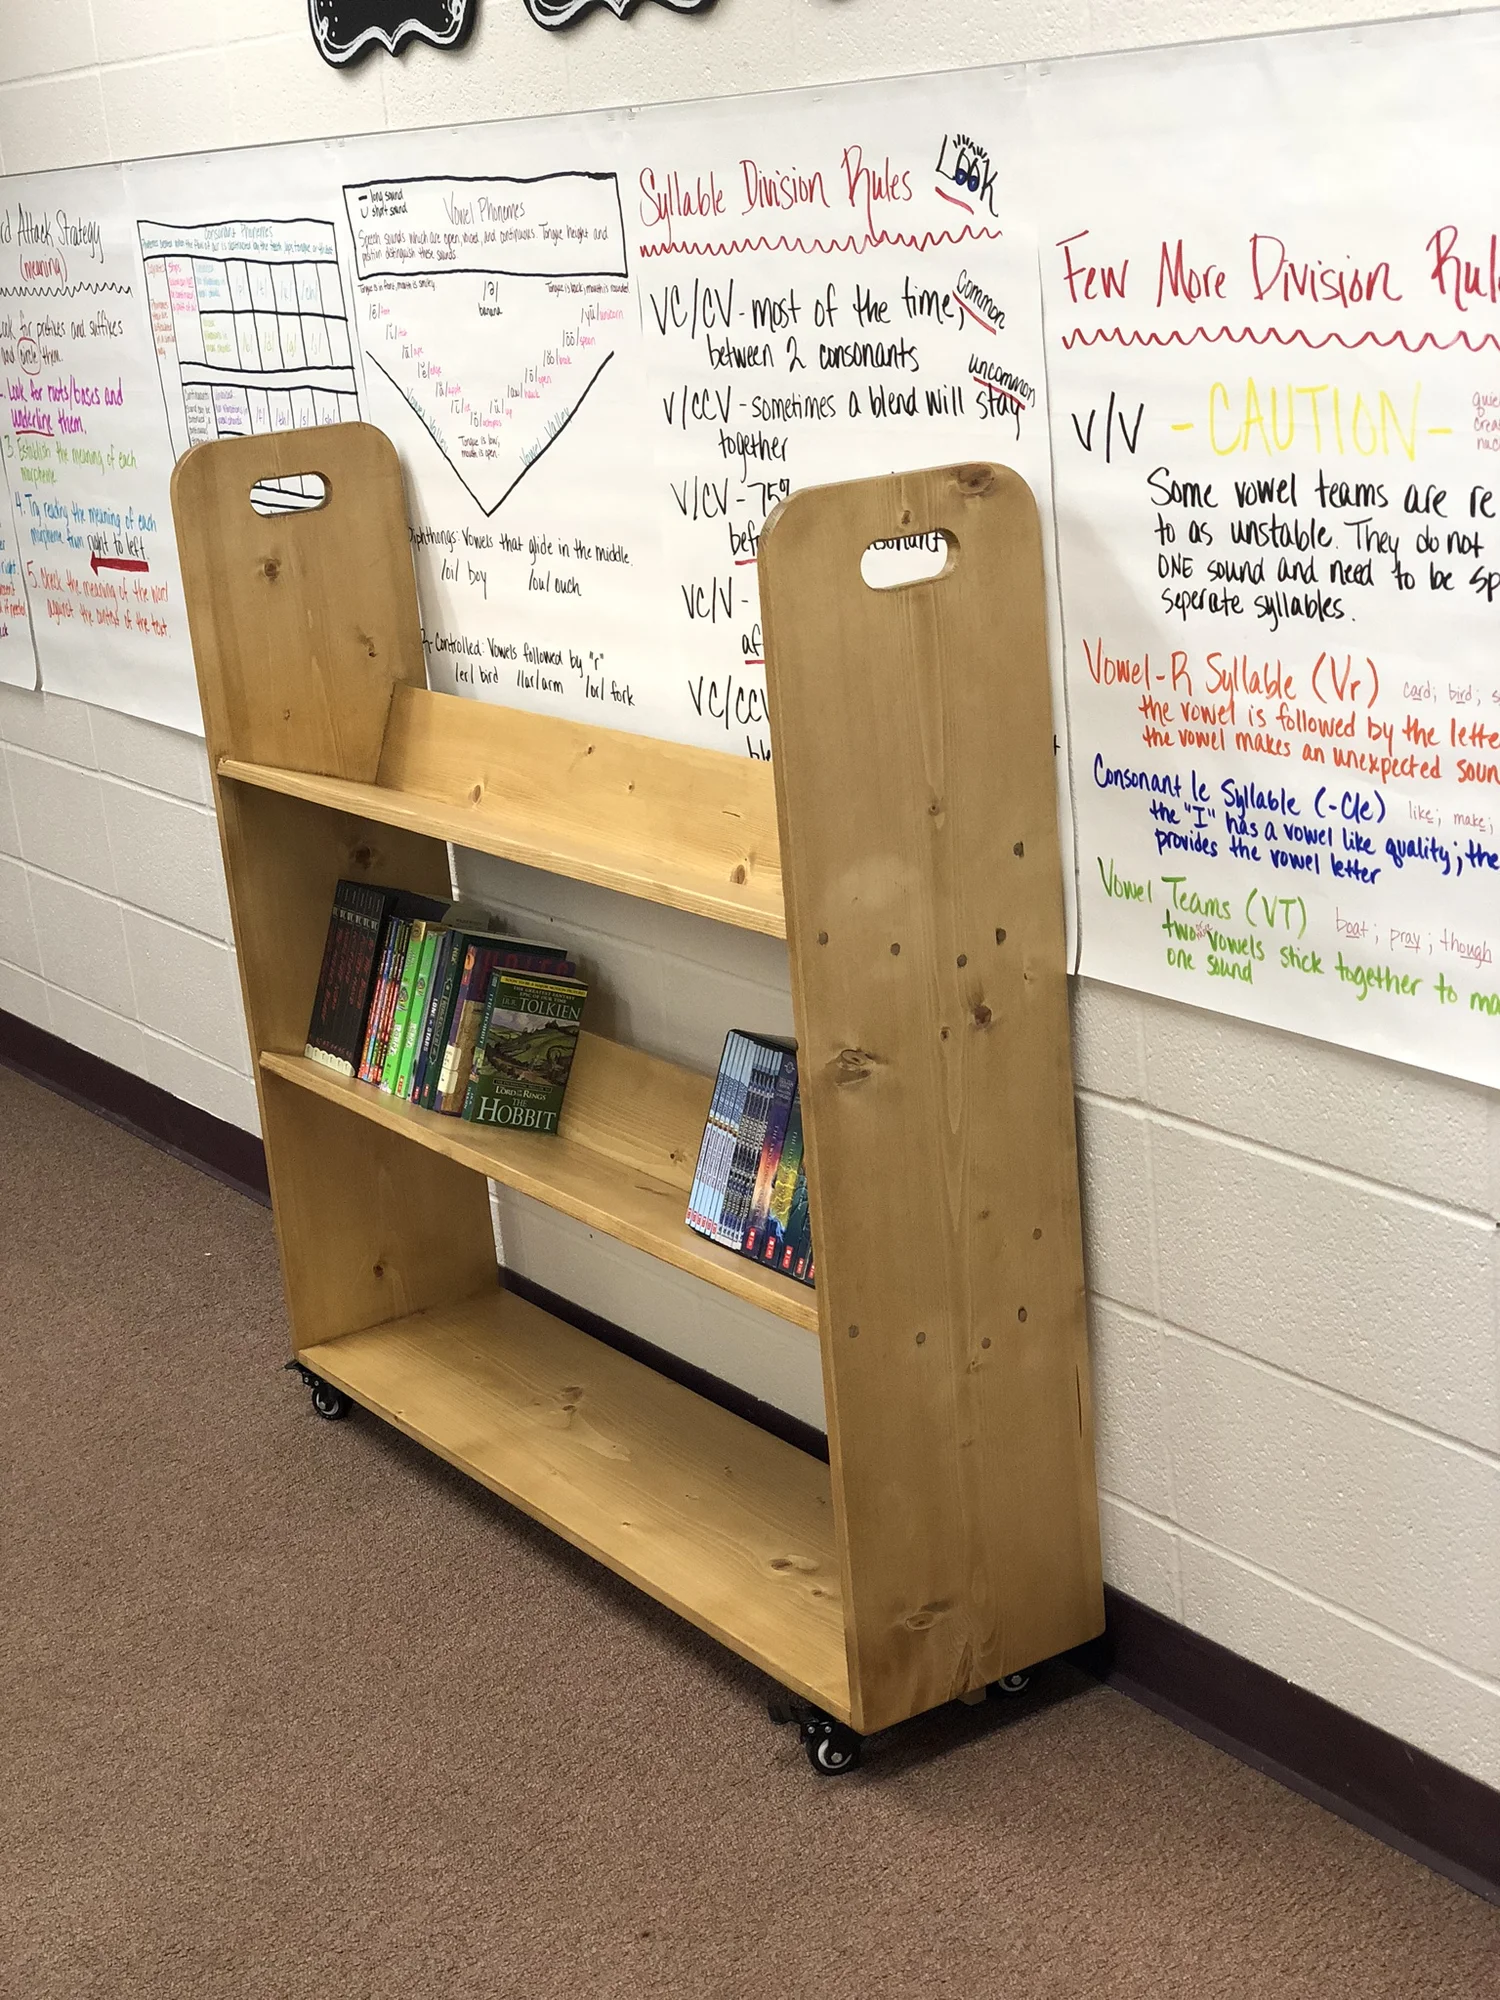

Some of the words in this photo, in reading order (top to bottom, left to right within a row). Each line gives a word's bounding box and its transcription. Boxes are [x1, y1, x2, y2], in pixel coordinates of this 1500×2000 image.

[443, 191, 475, 225] Vowel
[477, 196, 525, 223] Phonemes
[639, 167, 727, 251] Syllable
[739, 160, 830, 216] Division
[841, 145, 913, 246] Rules
[17, 203, 54, 247] Attack
[56, 210, 104, 263] Strategy
[20, 248, 68, 288] (meaning)
[1056, 230, 1129, 303] Few
[1157, 239, 1227, 308] More
[1250, 233, 1402, 308] Division
[20, 310, 32, 337] for
[71, 319, 86, 339] and
[90, 310, 123, 338] suffixes
[752, 294, 802, 332] most
[814, 282, 836, 327] of
[853, 284, 891, 324] the
[706, 334, 774, 370] between
[787, 336, 806, 372] 2
[819, 336, 919, 372] consonants
[7, 377, 27, 402] Look
[30, 378, 43, 401] for
[105, 377, 124, 406] and
[849, 396, 862, 416] a
[868, 386, 919, 416] blend
[926, 385, 964, 416] will
[976, 382, 1023, 440] stay
[11, 406, 53, 432] underline
[58, 409, 87, 434] them.
[56, 441, 69, 464] the
[72, 449, 105, 476] meaning
[107, 445, 115, 469] of
[119, 450, 136, 469] each
[718, 428, 789, 483] together
[1147, 467, 1219, 508] Some
[1234, 472, 1298, 507] vowel
[1315, 469, 1388, 509] teams
[1403, 484, 1448, 518] are
[72, 501, 85, 523] the
[88, 508, 121, 536] meaning
[125, 506, 135, 529] of
[138, 513, 157, 532] each
[113, 532, 123, 554] to
[462, 526, 494, 548] Vowels
[499, 533, 524, 552] that
[528, 534, 553, 565] glide
[558, 537, 570, 557] in
[574, 538, 592, 559] the
[1154, 513, 1176, 546] to
[1188, 520, 1214, 546] as
[1229, 512, 1339, 551] unstable.
[1344, 517, 1400, 574] They
[1416, 524, 1440, 554] do
[1447, 531, 1485, 558] not
[40, 567, 64, 592] Check
[66, 569, 81, 594] the
[119, 577, 128, 602] of
[133, 580, 148, 602] the
[151, 581, 168, 604] word
[467, 561, 487, 600] boy
[555, 576, 582, 596] ouch
[1158, 553, 1193, 578] ONE
[1207, 556, 1265, 585] sound
[1277, 555, 1319, 583] and
[1330, 557, 1374, 586] need
[1391, 561, 1416, 591] to
[1430, 561, 1455, 591] be
[80, 603, 94, 625] the
[124, 609, 133, 629] of
[136, 612, 149, 633] the
[1161, 587, 1244, 621] seperate
[1255, 588, 1356, 632] syllables.
[487, 637, 517, 660] Vowels
[523, 643, 563, 665] followed
[569, 649, 583, 678] by
[1206, 647, 1296, 706] Syllable
[1312, 651, 1379, 708] (Vr)
[479, 664, 498, 684] bird
[610, 681, 635, 706] fork
[1138, 695, 1175, 722] the
[1180, 698, 1236, 727] vowel
[1248, 703, 1267, 728] is
[1275, 704, 1356, 738] followed
[1368, 712, 1393, 756] by
[1402, 714, 1441, 748] the
[1143, 725, 1174, 749] the
[1179, 727, 1225, 752] vowel
[1235, 730, 1291, 757] makes
[1303, 742, 1326, 764] an
[1332, 747, 1442, 783] unexpected
[1093, 752, 1182, 798] Consonant
[1220, 778, 1301, 818] Syllable
[1149, 799, 1180, 826] the
[1226, 812, 1261, 836] has
[1265, 824, 1279, 841] a
[1283, 823, 1333, 848] vowel
[1342, 829, 1376, 856] like
[1155, 829, 1218, 858] provides
[1229, 838, 1261, 862] the
[1270, 846, 1320, 875] vowel
[1330, 851, 1381, 885] letter
[1098, 856, 1152, 904] Vowel
[1161, 875, 1231, 920] Teams
[1245, 888, 1307, 940] (VT)
[1440, 927, 1493, 969] though
[1162, 908, 1196, 942] two
[1206, 930, 1266, 962] vowels
[1280, 946, 1325, 975] stick
[1335, 951, 1422, 1002] together
[1434, 972, 1458, 1004] to
[1167, 947, 1196, 970] one
[1207, 954, 1254, 985] sound
[520, 997, 581, 1021] TOLKIEN
[477, 1096, 557, 1131] HOBBIT
